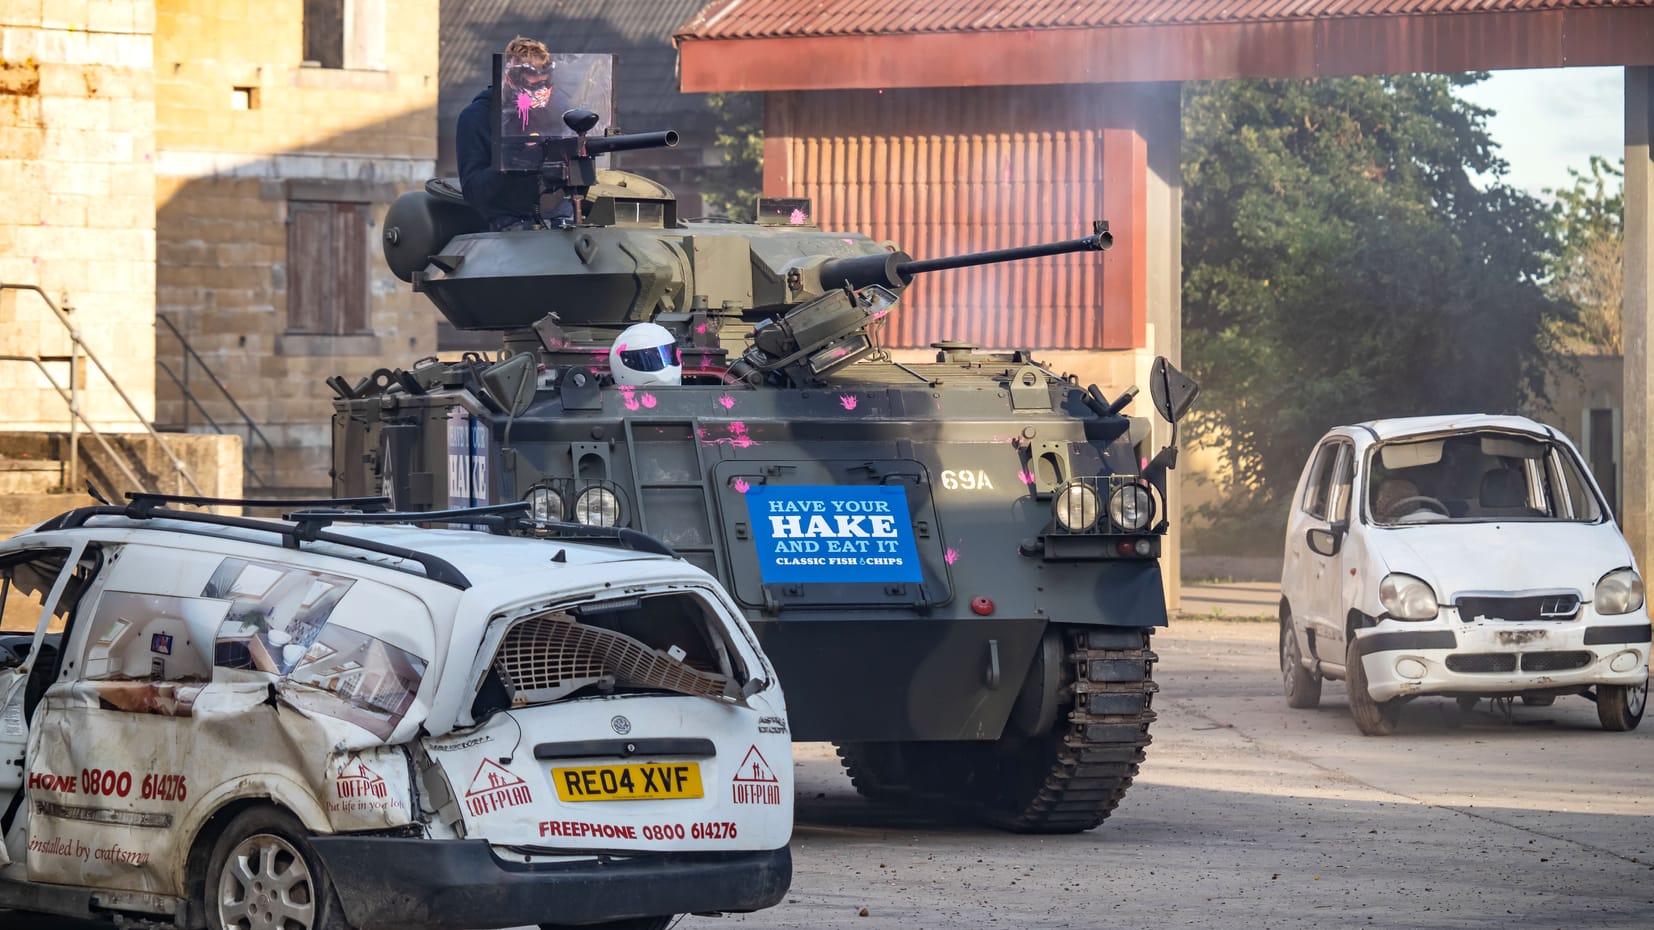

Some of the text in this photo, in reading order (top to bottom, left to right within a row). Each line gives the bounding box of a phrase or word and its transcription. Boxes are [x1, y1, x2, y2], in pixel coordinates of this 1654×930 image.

[449, 454, 486, 500] HAKE
[941, 470, 994, 490] 69A
[768, 500, 890, 513] HAVE YOUR
[768, 515, 898, 538] HAKE
[774, 540, 899, 553] AND EAT IT
[775, 557, 826, 566] CLASSIC
[829, 557, 857, 566] FISH
[866, 557, 903, 566] CHIPS
[28, 768, 187, 802] HONE 0800 614276
[563, 766, 689, 796] RE04 XVF
[357, 799, 367, 811] in
[538, 820, 738, 841] FREEPHONE 0800 614276
[28, 834, 73, 857] installed
[75, 839, 91, 863] by
